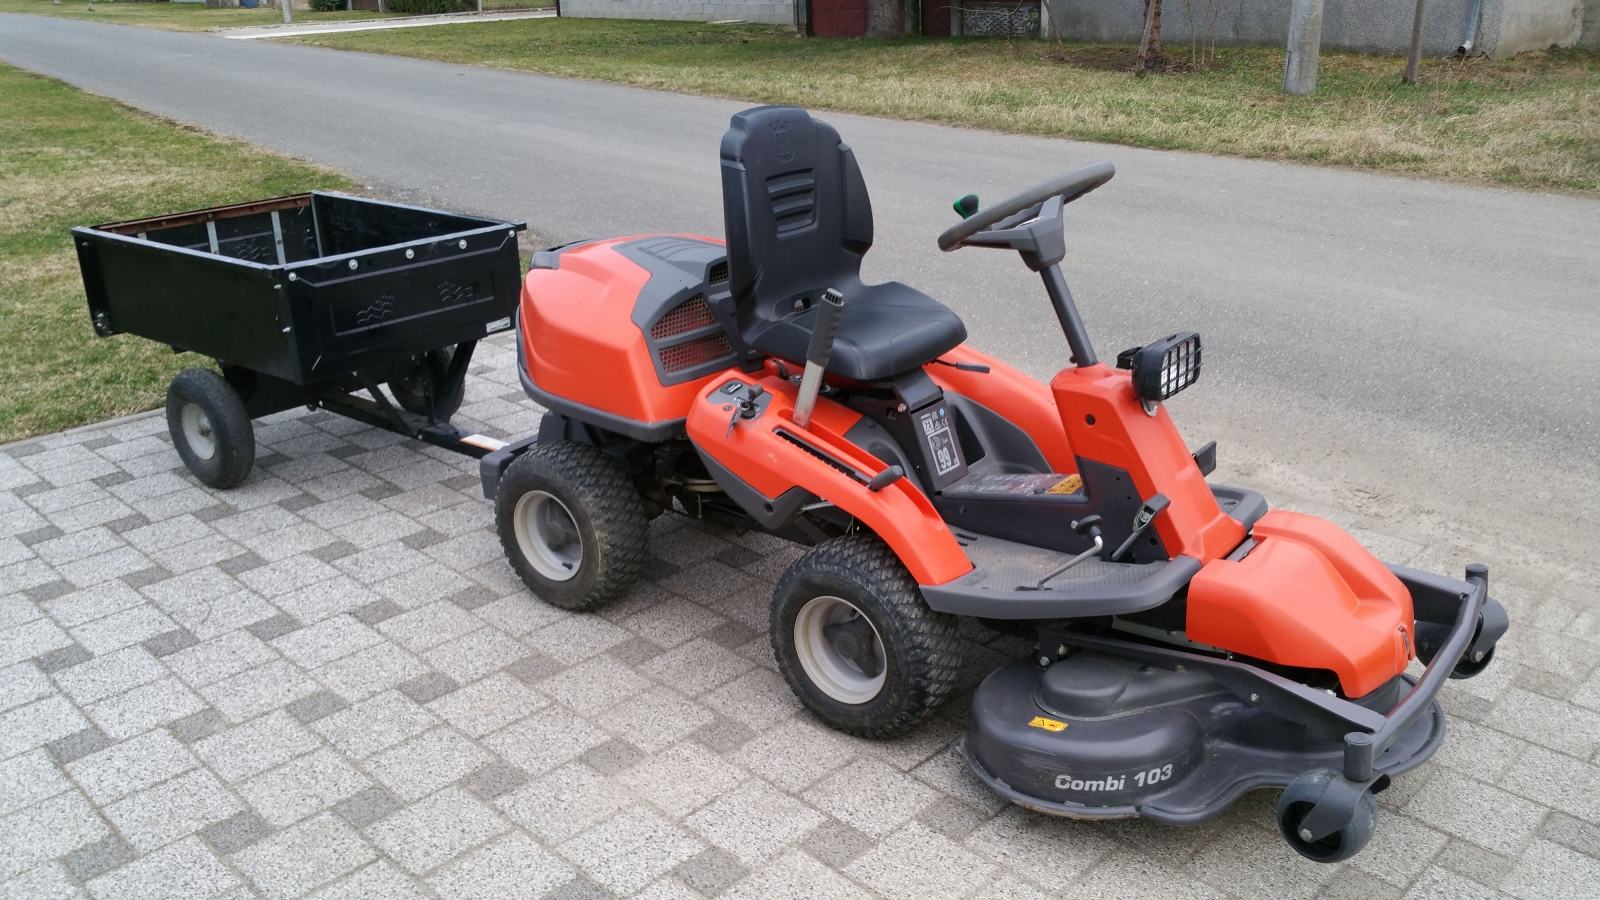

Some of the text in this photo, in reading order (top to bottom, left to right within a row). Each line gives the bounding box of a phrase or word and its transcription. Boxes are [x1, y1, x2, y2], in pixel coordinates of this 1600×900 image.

[937, 447, 952, 470] 99
[1054, 763, 1173, 792] Combi 103
